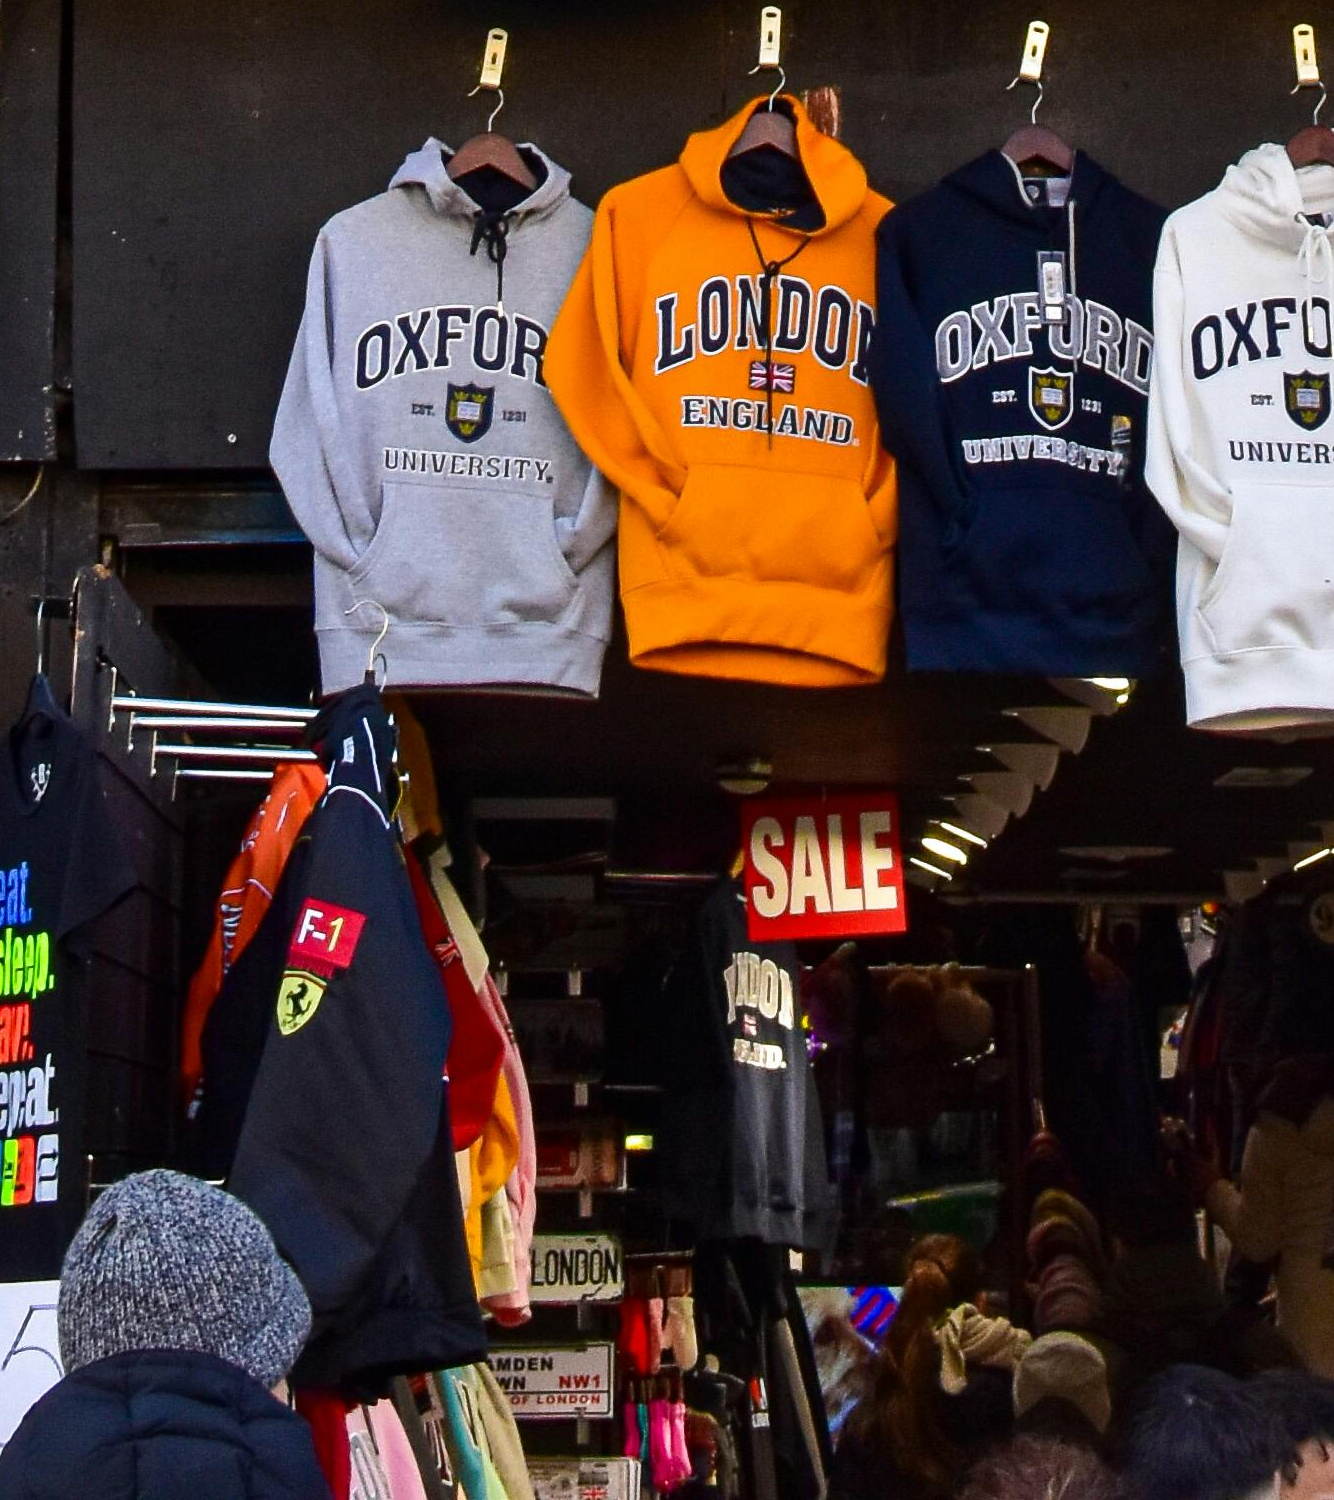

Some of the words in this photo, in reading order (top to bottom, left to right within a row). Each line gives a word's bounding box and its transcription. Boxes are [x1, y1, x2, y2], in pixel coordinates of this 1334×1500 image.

[355, 304, 550, 392] OXFOR
[935, 292, 1153, 396] OXFORD
[681, 395, 855, 445] ENGLAND
[750, 811, 898, 918] SALE
[297, 907, 345, 953] F-1
[531, 1249, 619, 1286] LONDON
[537, 1394, 601, 1405] LONDON
[558, 1374, 601, 1389] NW1
